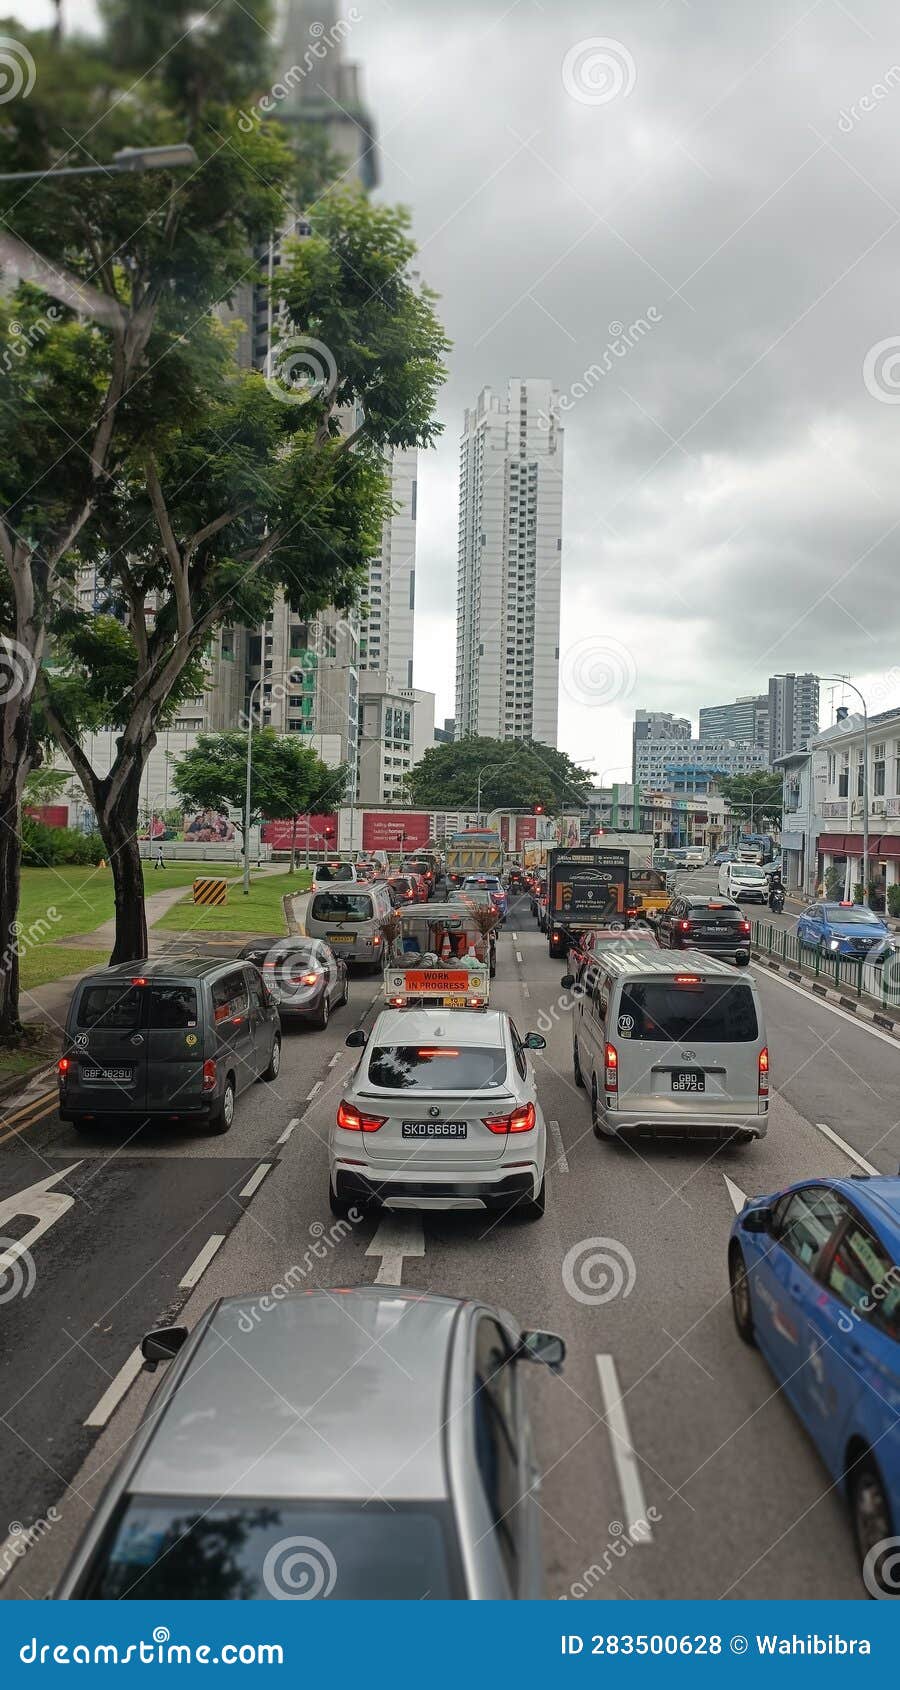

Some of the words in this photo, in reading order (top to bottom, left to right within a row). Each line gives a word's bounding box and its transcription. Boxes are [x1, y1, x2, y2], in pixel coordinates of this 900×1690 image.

[423, 971, 449, 980] WORK
[408, 982, 418, 990] IN
[420, 982, 465, 990] PROGRESS
[620, 1016, 631, 1026] 70
[75, 1035, 87, 1045] 70
[672, 1081, 704, 1091] 8872C
